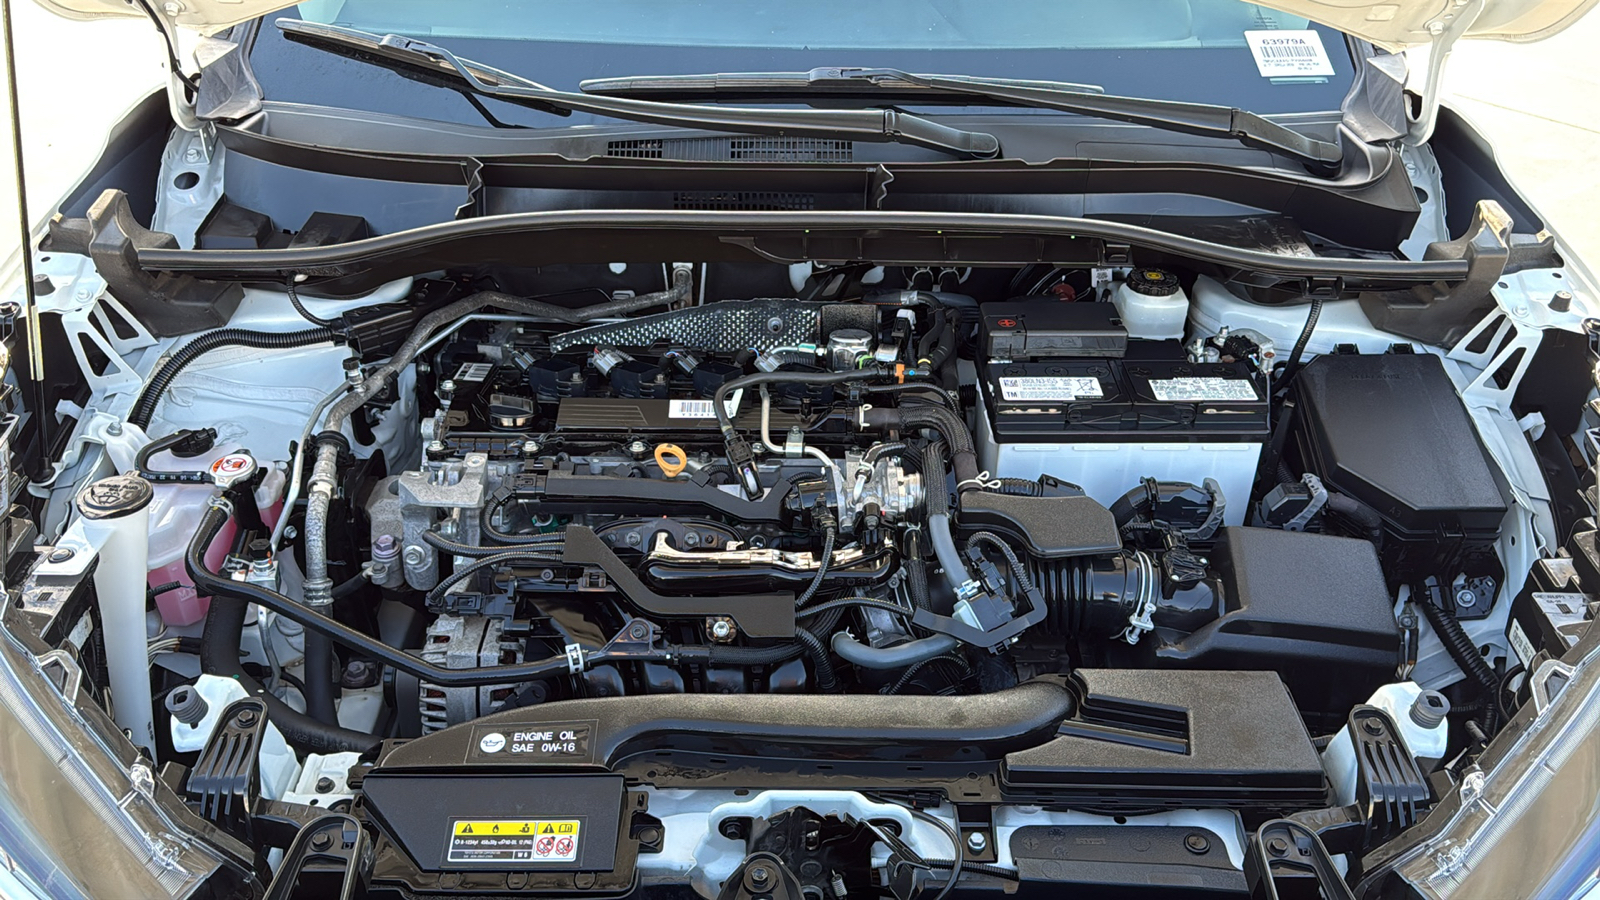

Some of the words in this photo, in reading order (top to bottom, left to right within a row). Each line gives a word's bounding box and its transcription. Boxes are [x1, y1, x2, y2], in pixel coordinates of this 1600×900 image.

[513, 731, 554, 741] ENGINE
[559, 731, 577, 740] OIL
[511, 743, 535, 753] SAE
[541, 742, 576, 753] 0W-16
